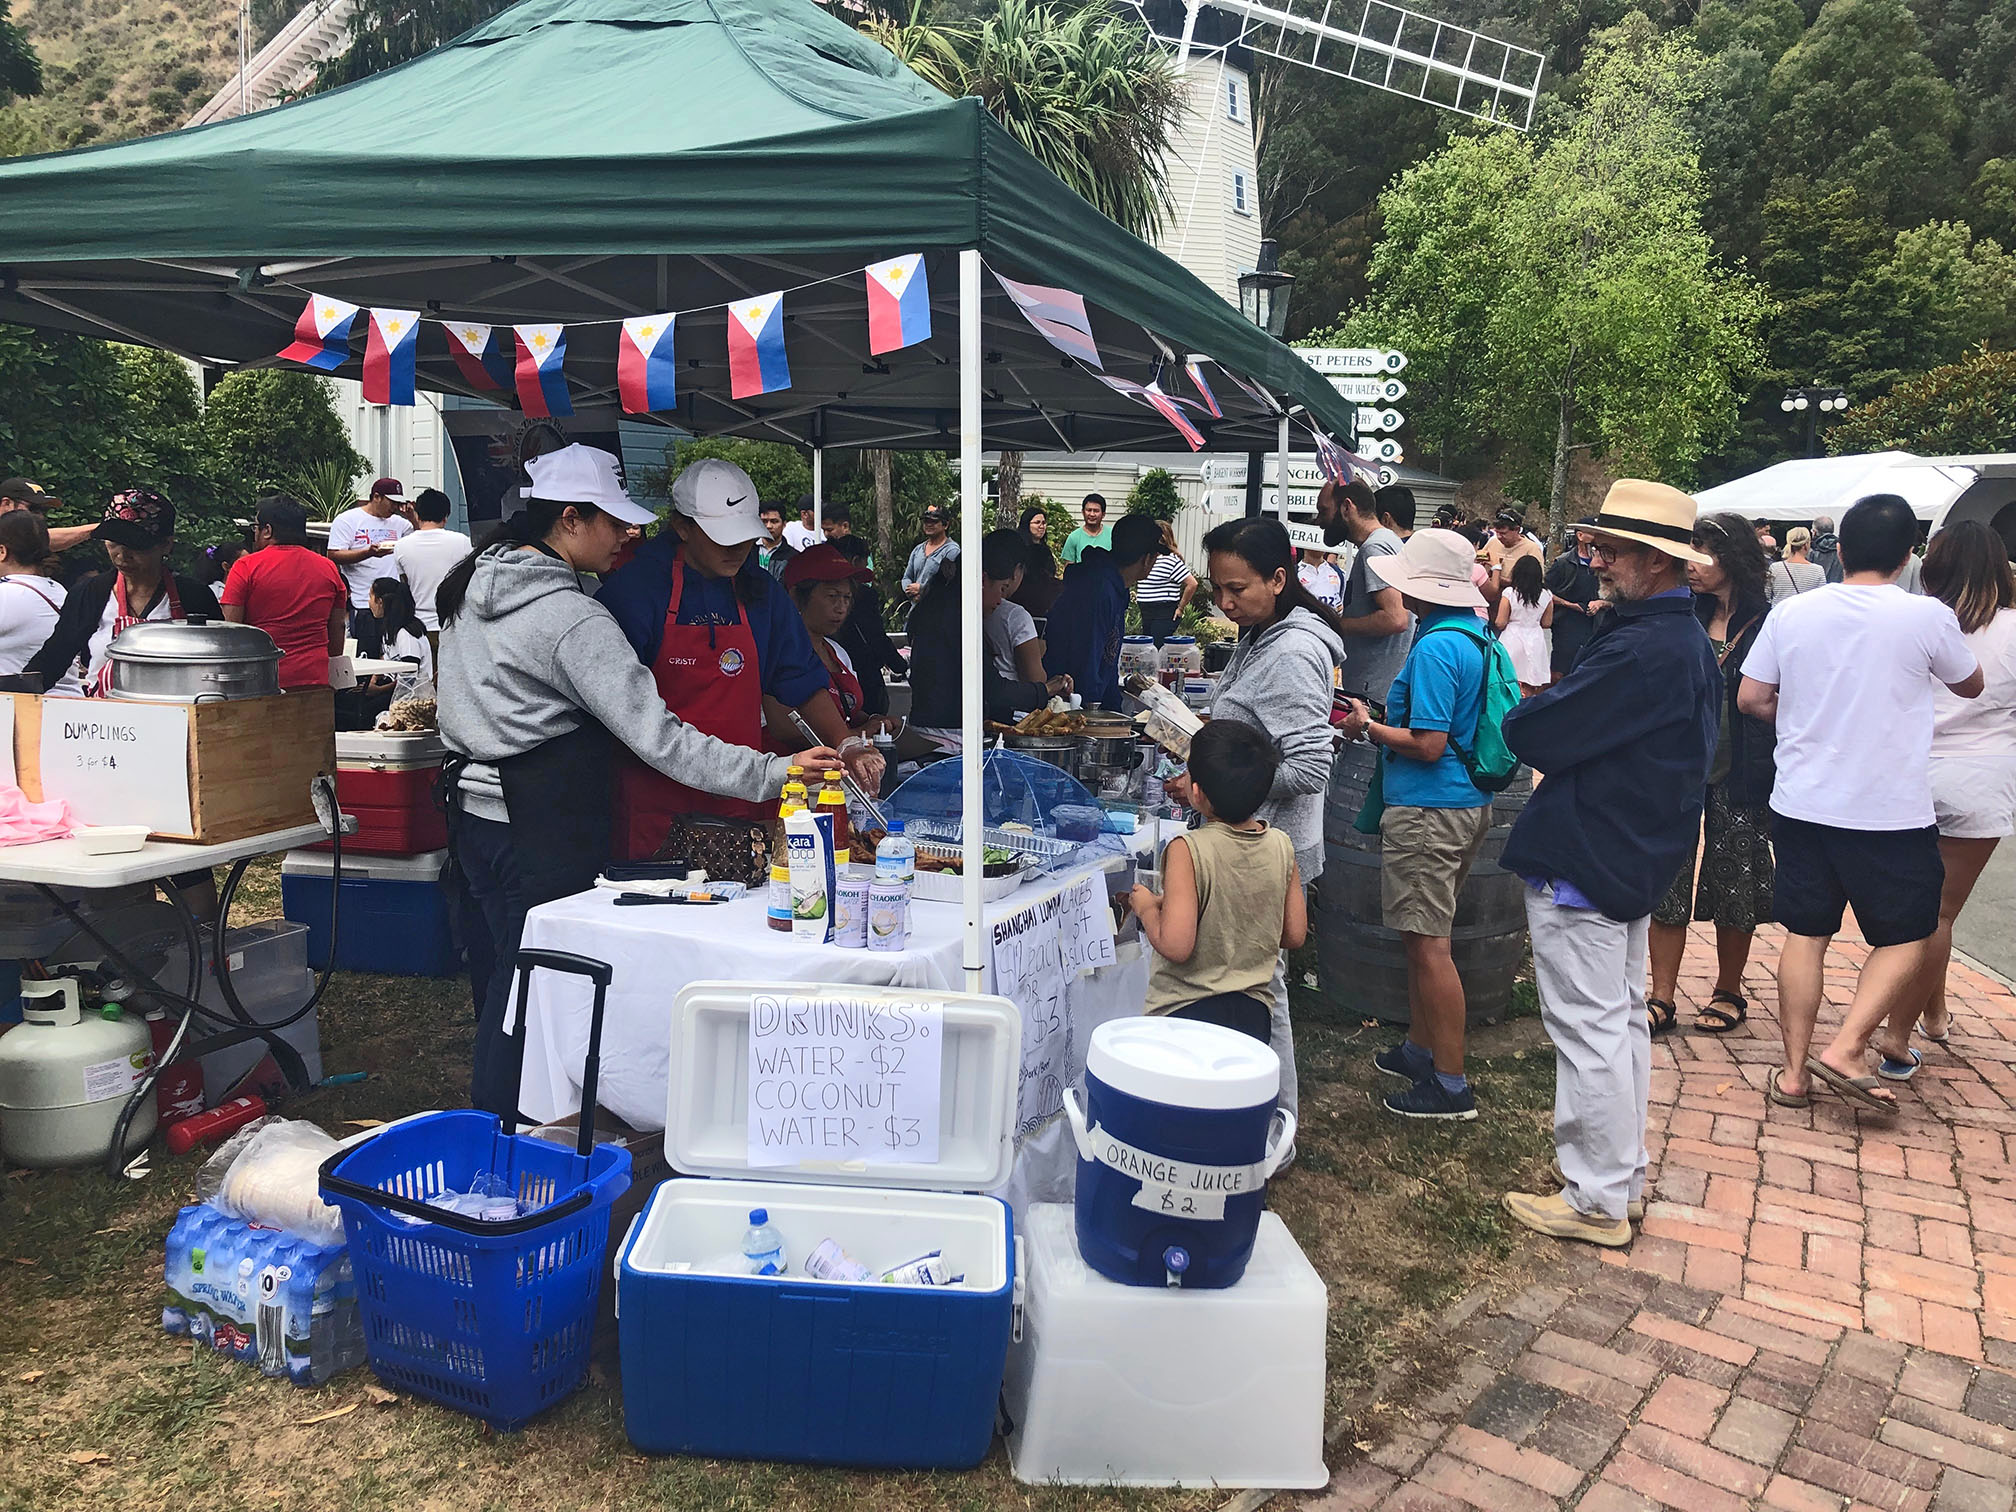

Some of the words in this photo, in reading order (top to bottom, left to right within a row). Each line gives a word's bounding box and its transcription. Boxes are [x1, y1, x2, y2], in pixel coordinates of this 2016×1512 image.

[1307, 355, 1323, 366] ST.
[1327, 356, 1373, 367] PETERS
[1355, 384, 1381, 396] WALES
[1387, 385, 1396, 395] 2
[1386, 415, 1394, 425] 3
[1383, 446, 1392, 456] 4
[1381, 471, 1390, 483] 5
[64, 722, 137, 742] DUMPLINGS
[76, 754, 84, 767] 3
[87, 756, 99, 772] for
[1061, 877, 1092, 914] CAKES
[993, 905, 1038, 946] SHANGHAI
[754, 995, 930, 1043] DRINKS:
[1031, 995, 1060, 1044] $3
[755, 1046, 845, 1077] WATER
[755, 1079, 902, 1113] COCONUT
[759, 1116, 860, 1148] WATER
[1107, 1144, 1178, 1184] ORANGE
[1190, 1168, 1243, 1192] JUICE
[192, 1282, 220, 1302] SPRING
